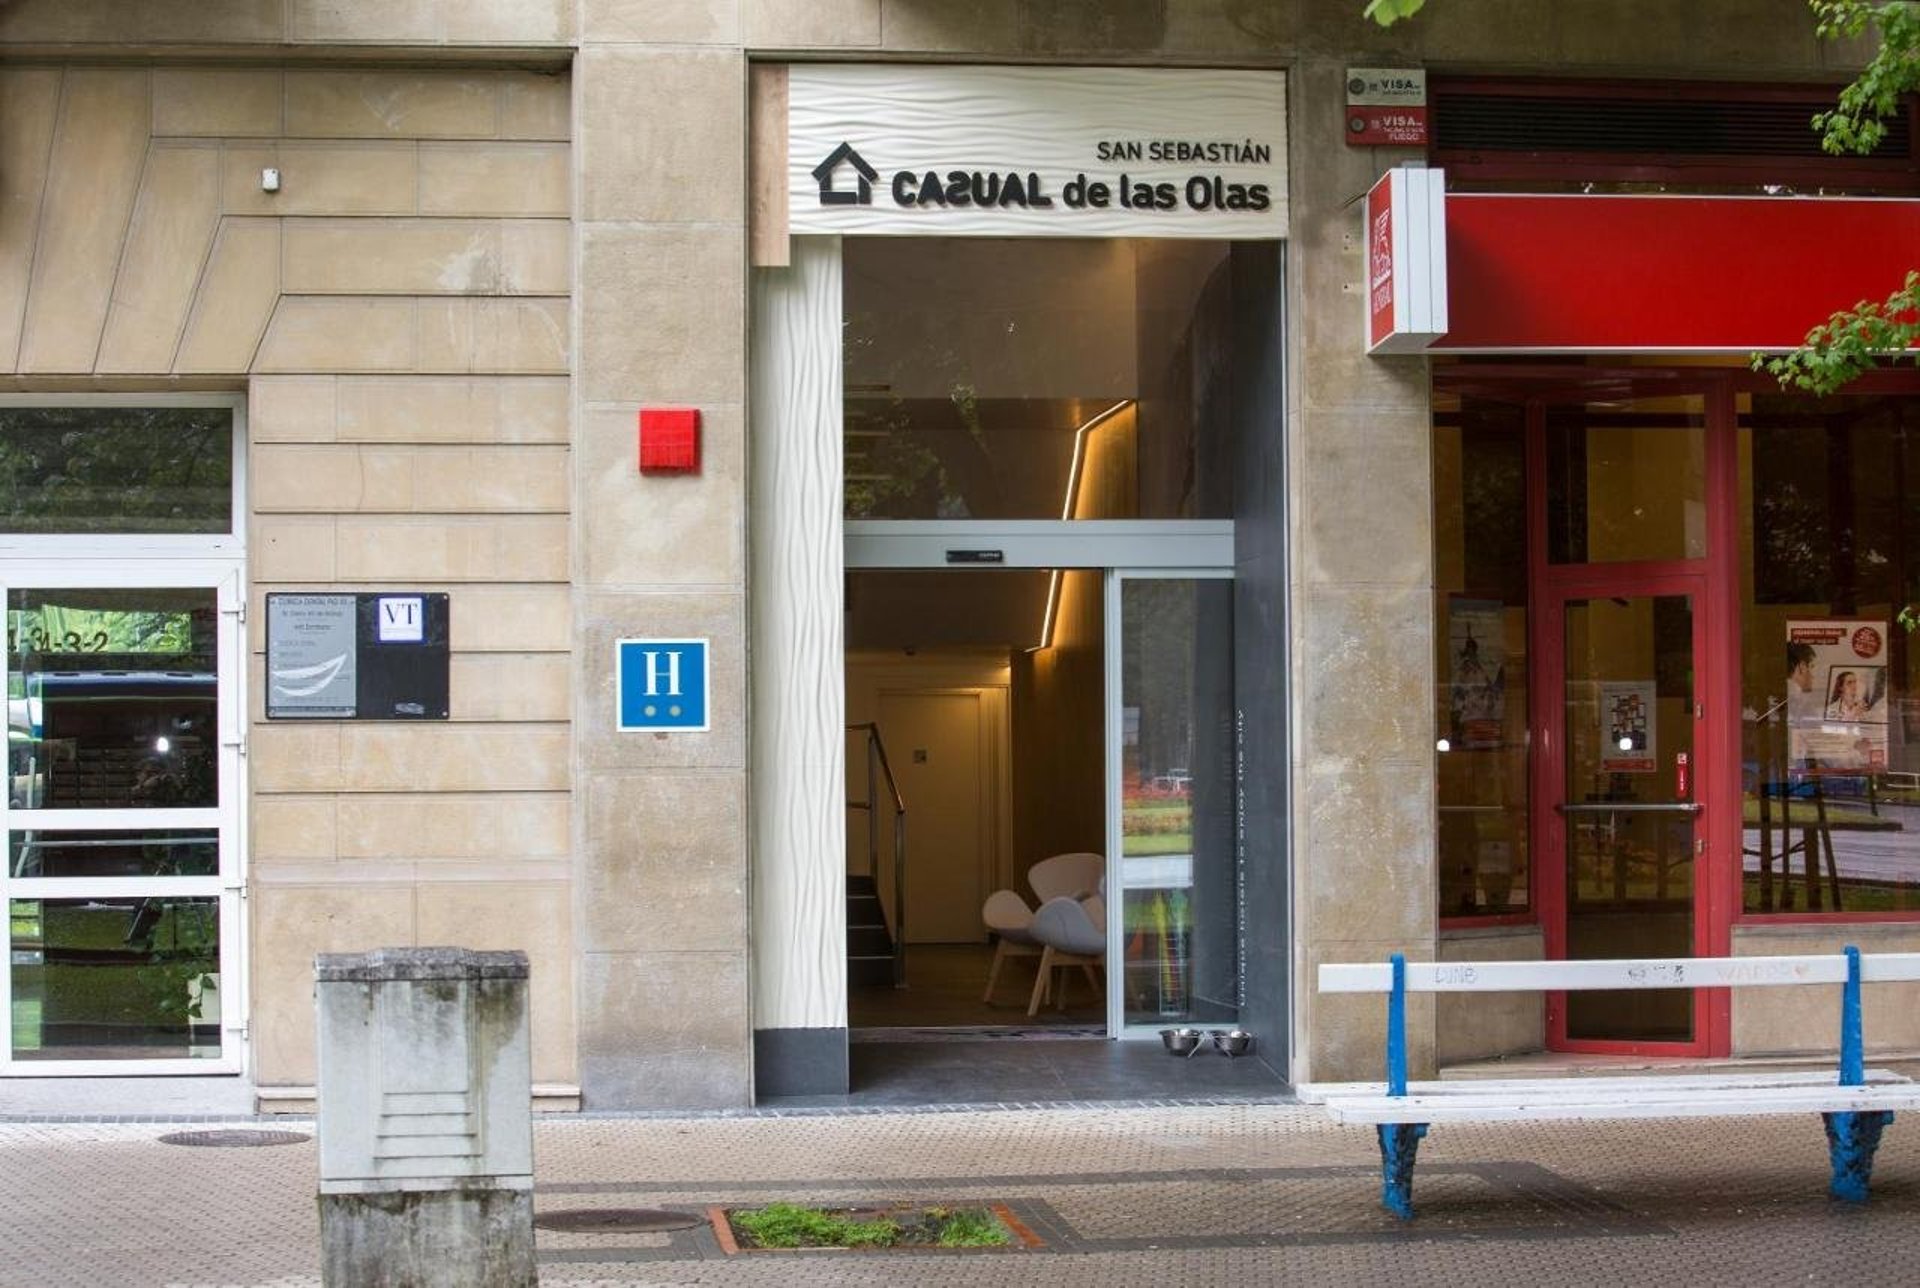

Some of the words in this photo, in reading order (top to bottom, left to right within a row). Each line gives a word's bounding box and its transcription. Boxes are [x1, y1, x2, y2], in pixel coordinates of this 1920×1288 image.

[1379, 79, 1414, 90] VISA
[1382, 116, 1416, 127] VISA
[1096, 141, 1141, 161] SAN
[1149, 138, 1271, 163] SEBASTIÁN
[892, 171, 1053, 208] CASUAL
[1063, 173, 1110, 209] de
[1120, 173, 1177, 210] las
[1186, 176, 1271, 211] Olas
[383, 602, 419, 626] VT
[641, 651, 684, 696] H
